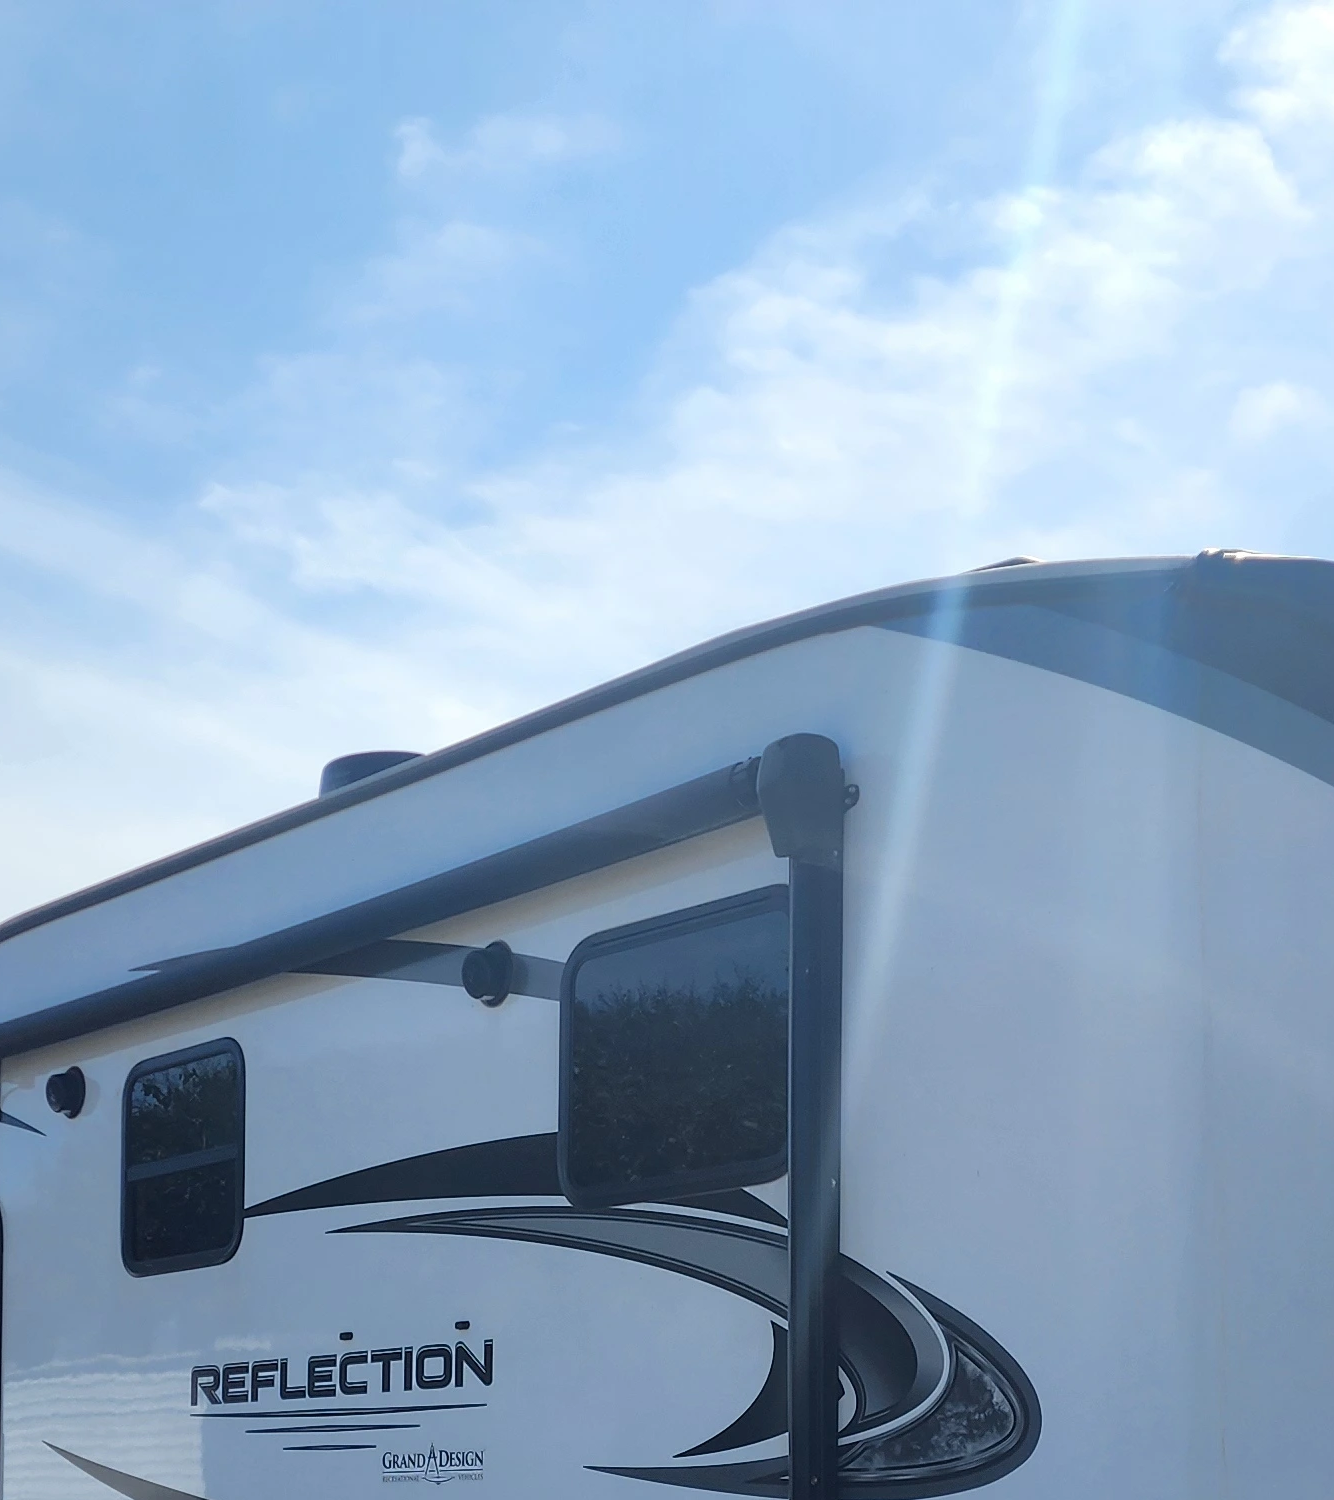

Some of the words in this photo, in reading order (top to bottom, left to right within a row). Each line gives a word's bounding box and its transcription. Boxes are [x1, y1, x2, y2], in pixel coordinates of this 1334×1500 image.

[190, 1338, 494, 1406] REFLECTION
[382, 1451, 426, 1469] GRAND
[439, 1449, 484, 1468] DESIGN
